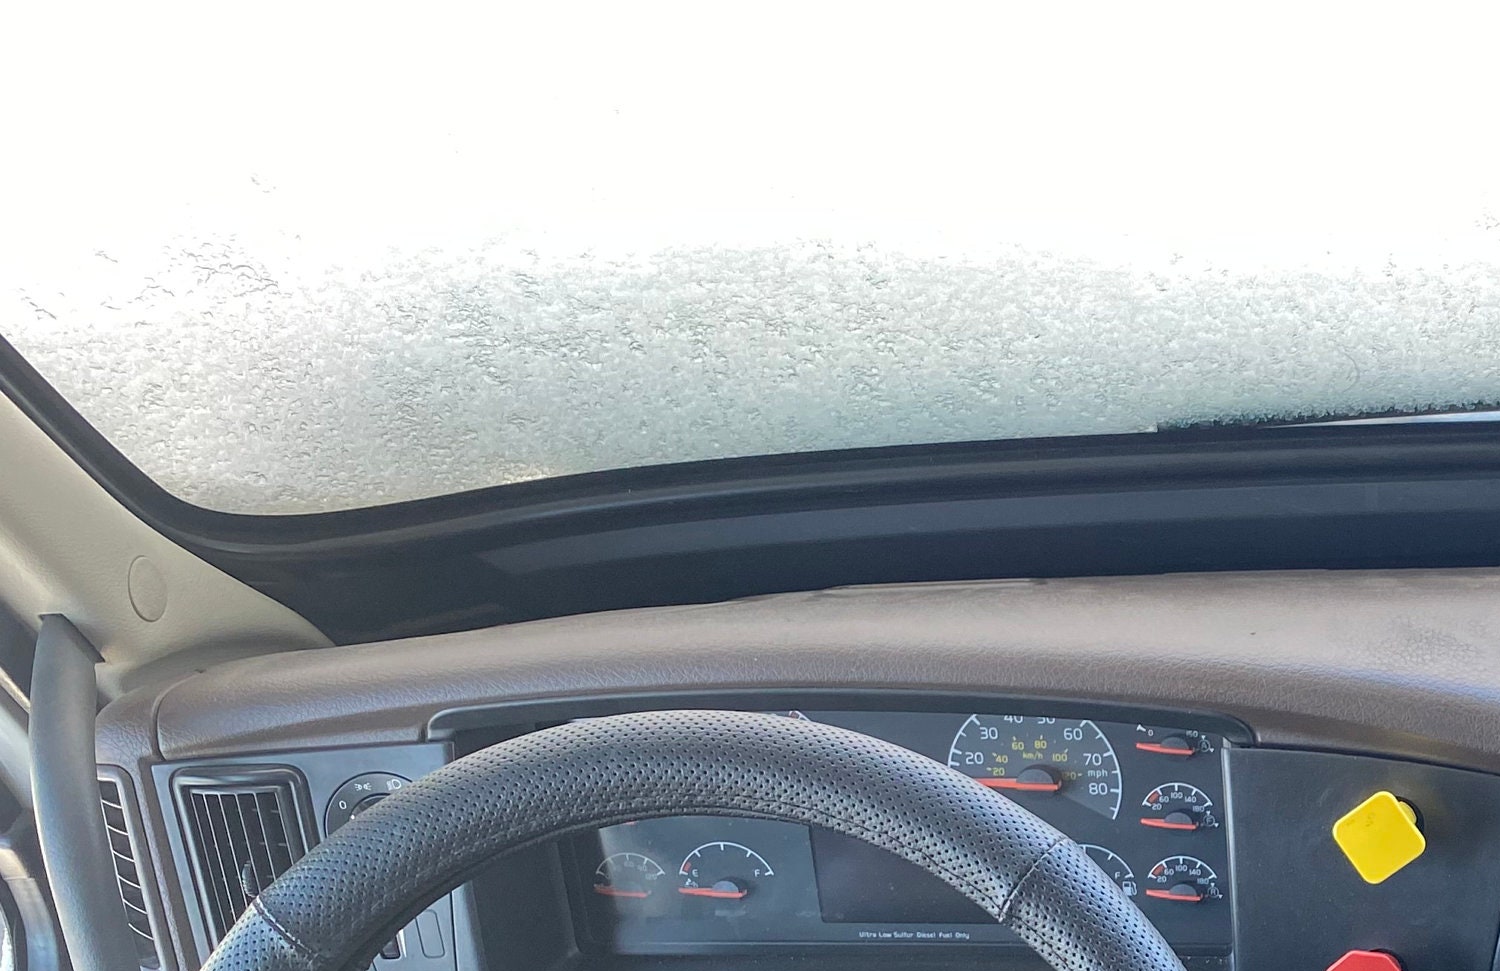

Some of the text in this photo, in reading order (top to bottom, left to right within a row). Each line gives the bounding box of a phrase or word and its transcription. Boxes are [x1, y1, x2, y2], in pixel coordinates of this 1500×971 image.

[980, 727, 998, 739] 30
[1064, 728, 1082, 740] 60
[1012, 742, 1024, 750] 60
[1035, 740, 1047, 749] 80
[966, 752, 983, 764] 20
[1052, 753, 1067, 762] 100
[1083, 754, 1102, 766] 70
[992, 768, 1004, 776] 20
[1088, 769, 1108, 779] mph
[1089, 783, 1108, 795] 80
[755, 869, 760, 877] F
